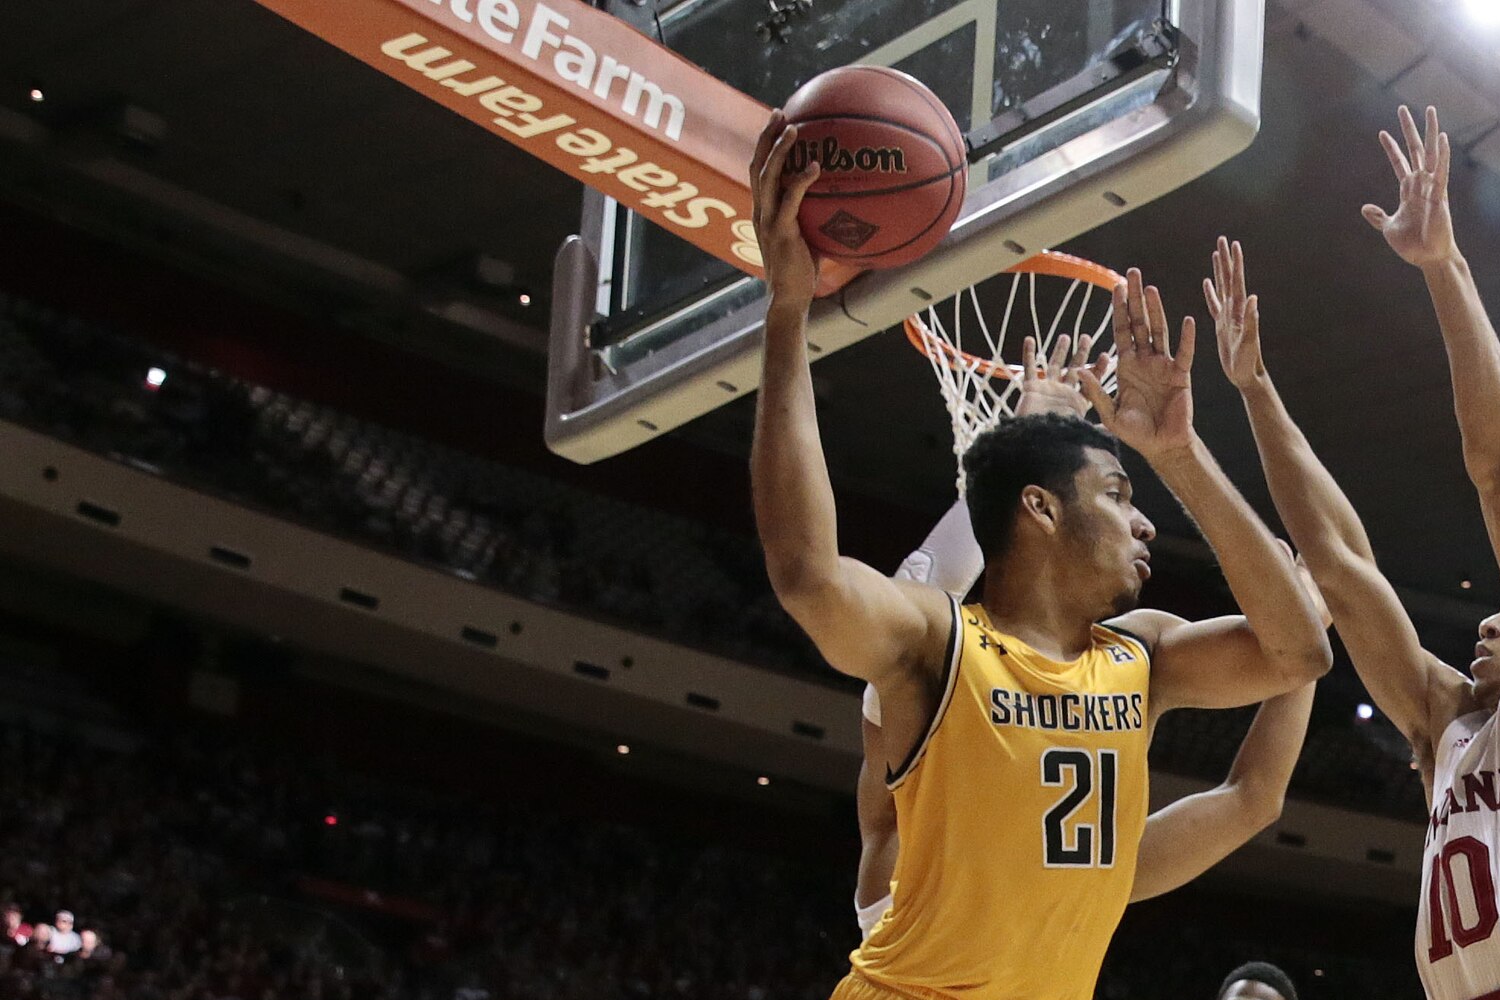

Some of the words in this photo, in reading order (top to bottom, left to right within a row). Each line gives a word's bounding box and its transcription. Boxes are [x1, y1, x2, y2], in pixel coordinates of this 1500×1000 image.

[990, 687, 1143, 733] SHOCKERS
[1041, 746, 1119, 868] 21
[1428, 835, 1499, 964] 10
